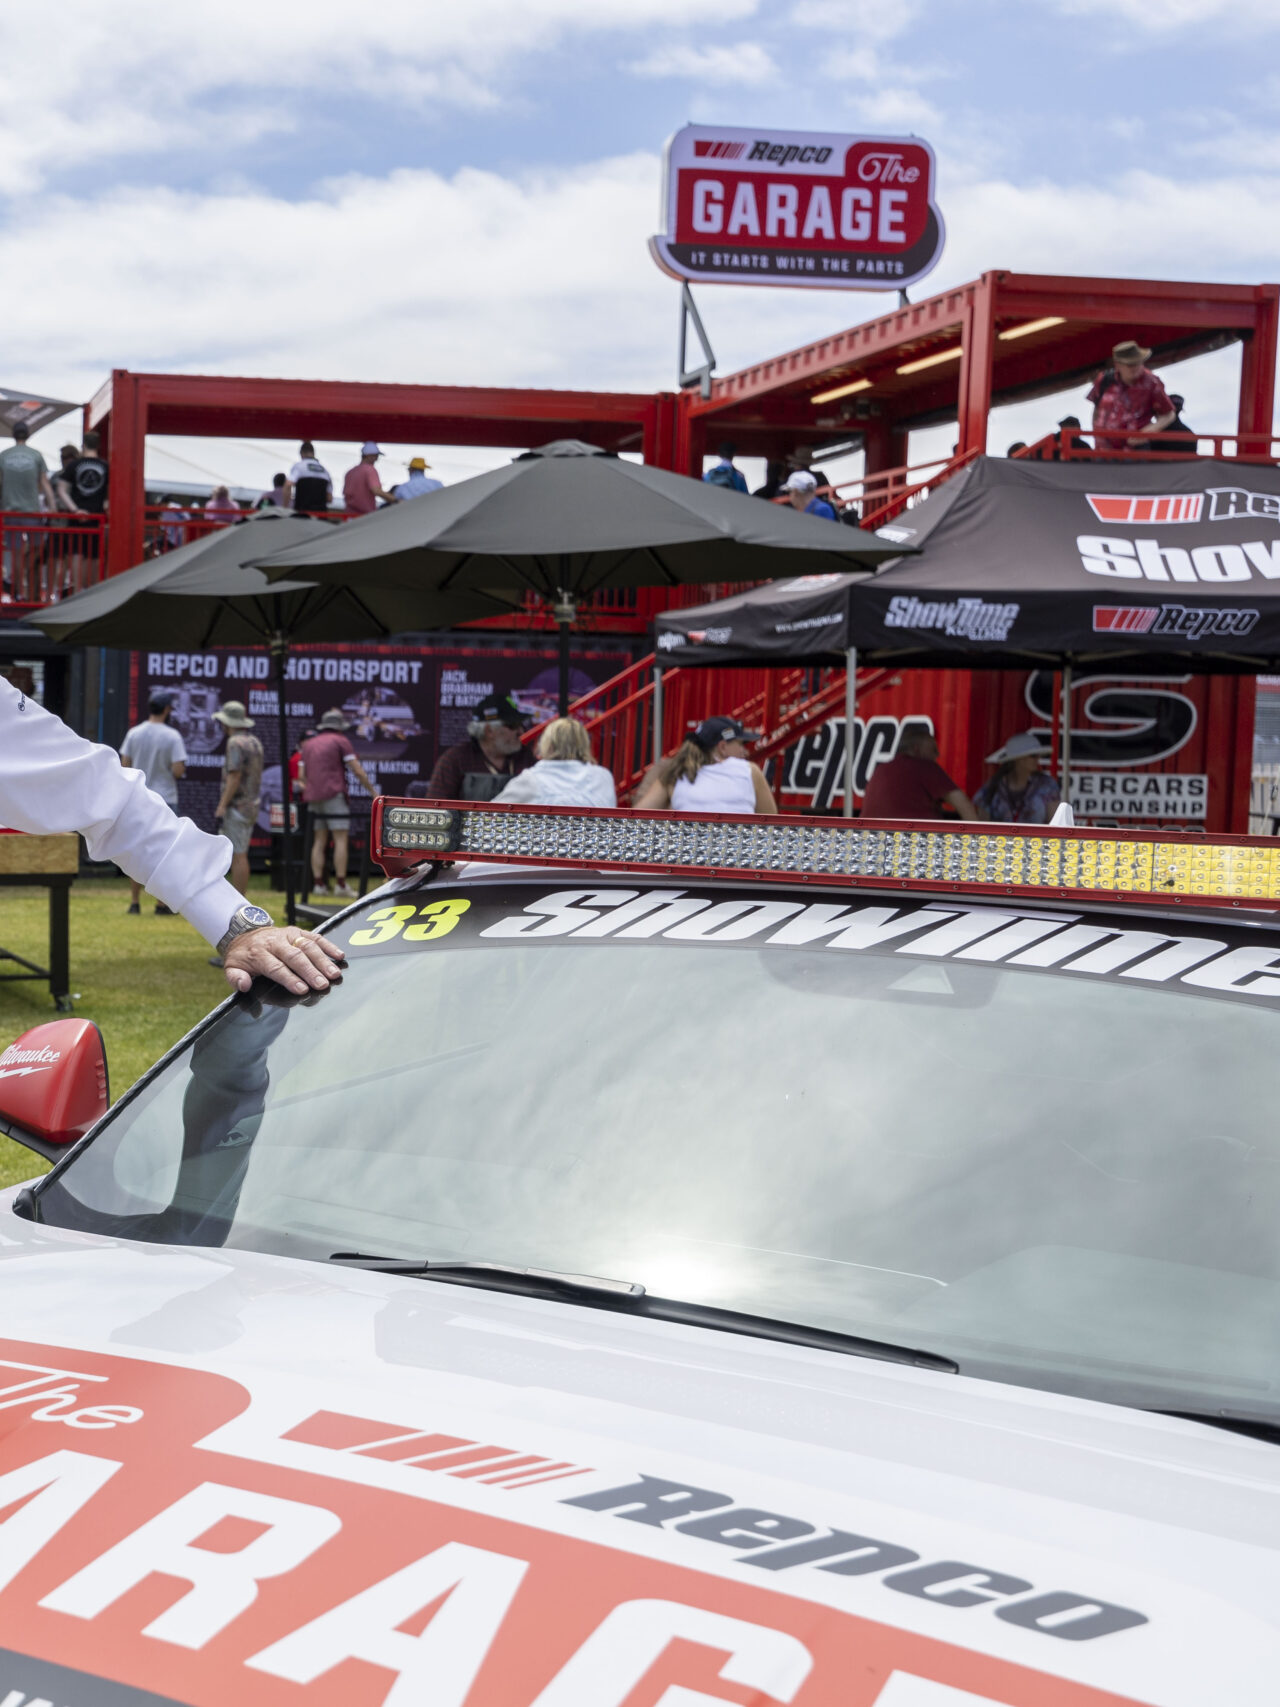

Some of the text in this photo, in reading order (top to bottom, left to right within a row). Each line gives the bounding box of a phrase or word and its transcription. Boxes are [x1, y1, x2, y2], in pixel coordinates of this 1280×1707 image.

[747, 140, 833, 166] Repco
[858, 152, 920, 184] The
[692, 179, 908, 243] GARAGE
[690, 251, 904, 275] IT STARTS WITH THE PARTS
[1152, 604, 1261, 640] Repco
[147, 653, 218, 678] REPCO
[224, 656, 269, 680] AND
[248, 689, 279, 702] FRAN
[348, 899, 472, 946] 33
[556, 1473, 1149, 1642] Repco
